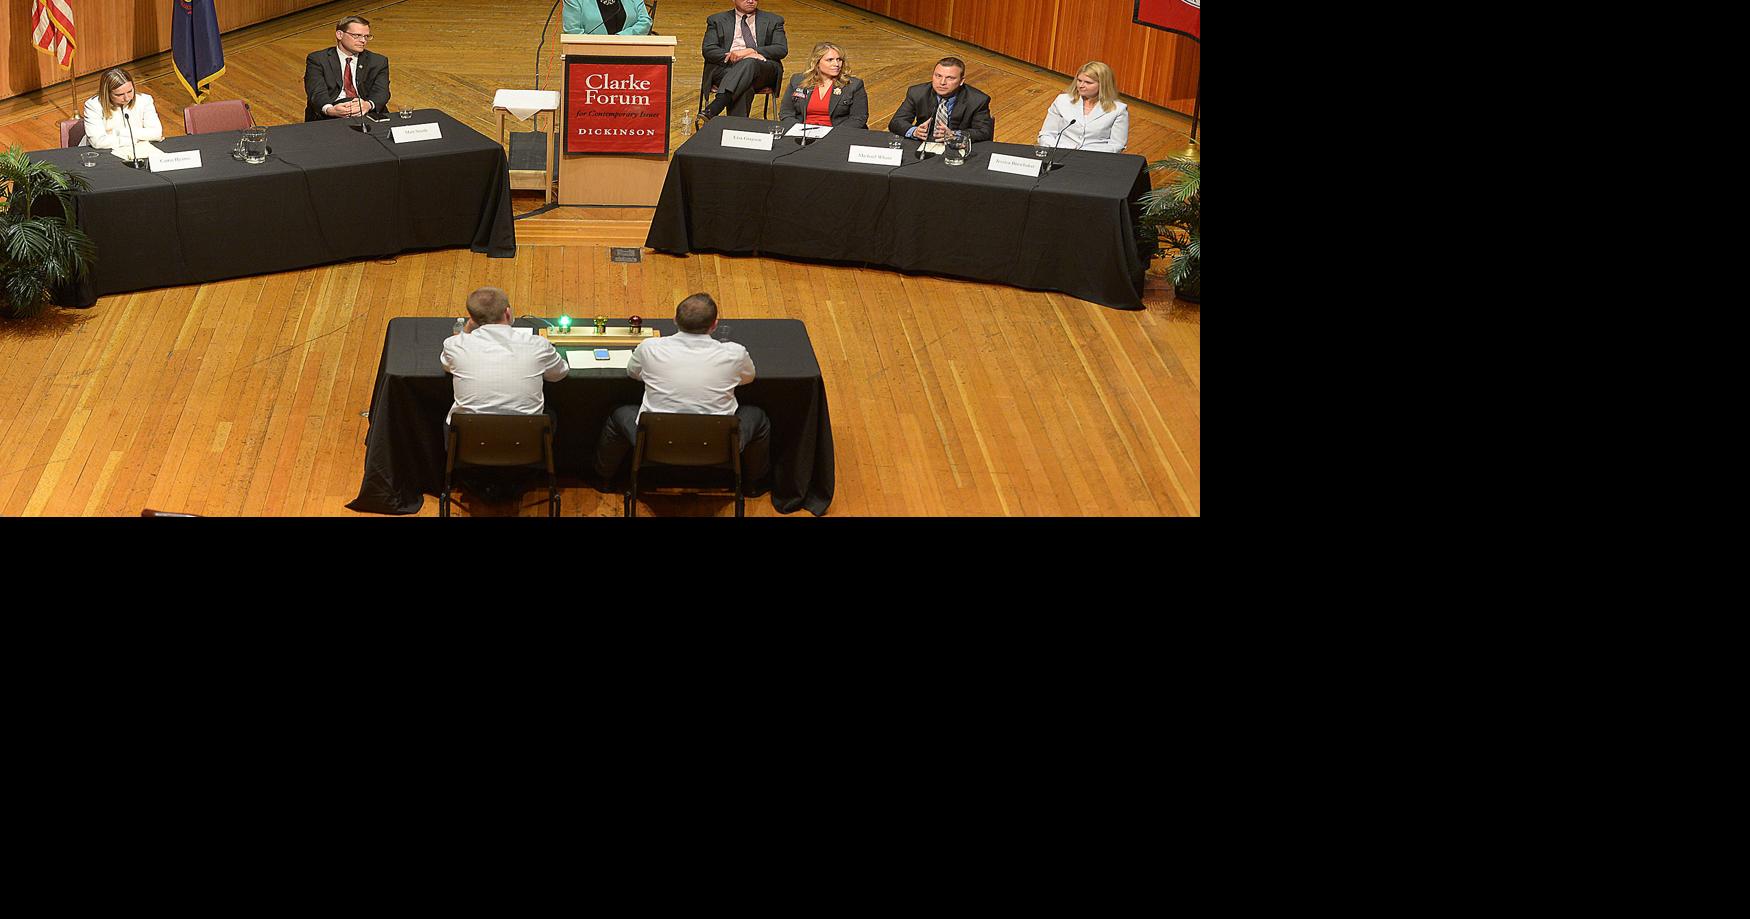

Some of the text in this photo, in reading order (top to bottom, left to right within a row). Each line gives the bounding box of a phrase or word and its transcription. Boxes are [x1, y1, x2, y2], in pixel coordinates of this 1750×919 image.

[585, 73, 651, 90] Clarke
[584, 89, 650, 106] Forum
[576, 110, 586, 118] for
[588, 110, 637, 119] Contemporary
[578, 128, 655, 136] DICKINSON
